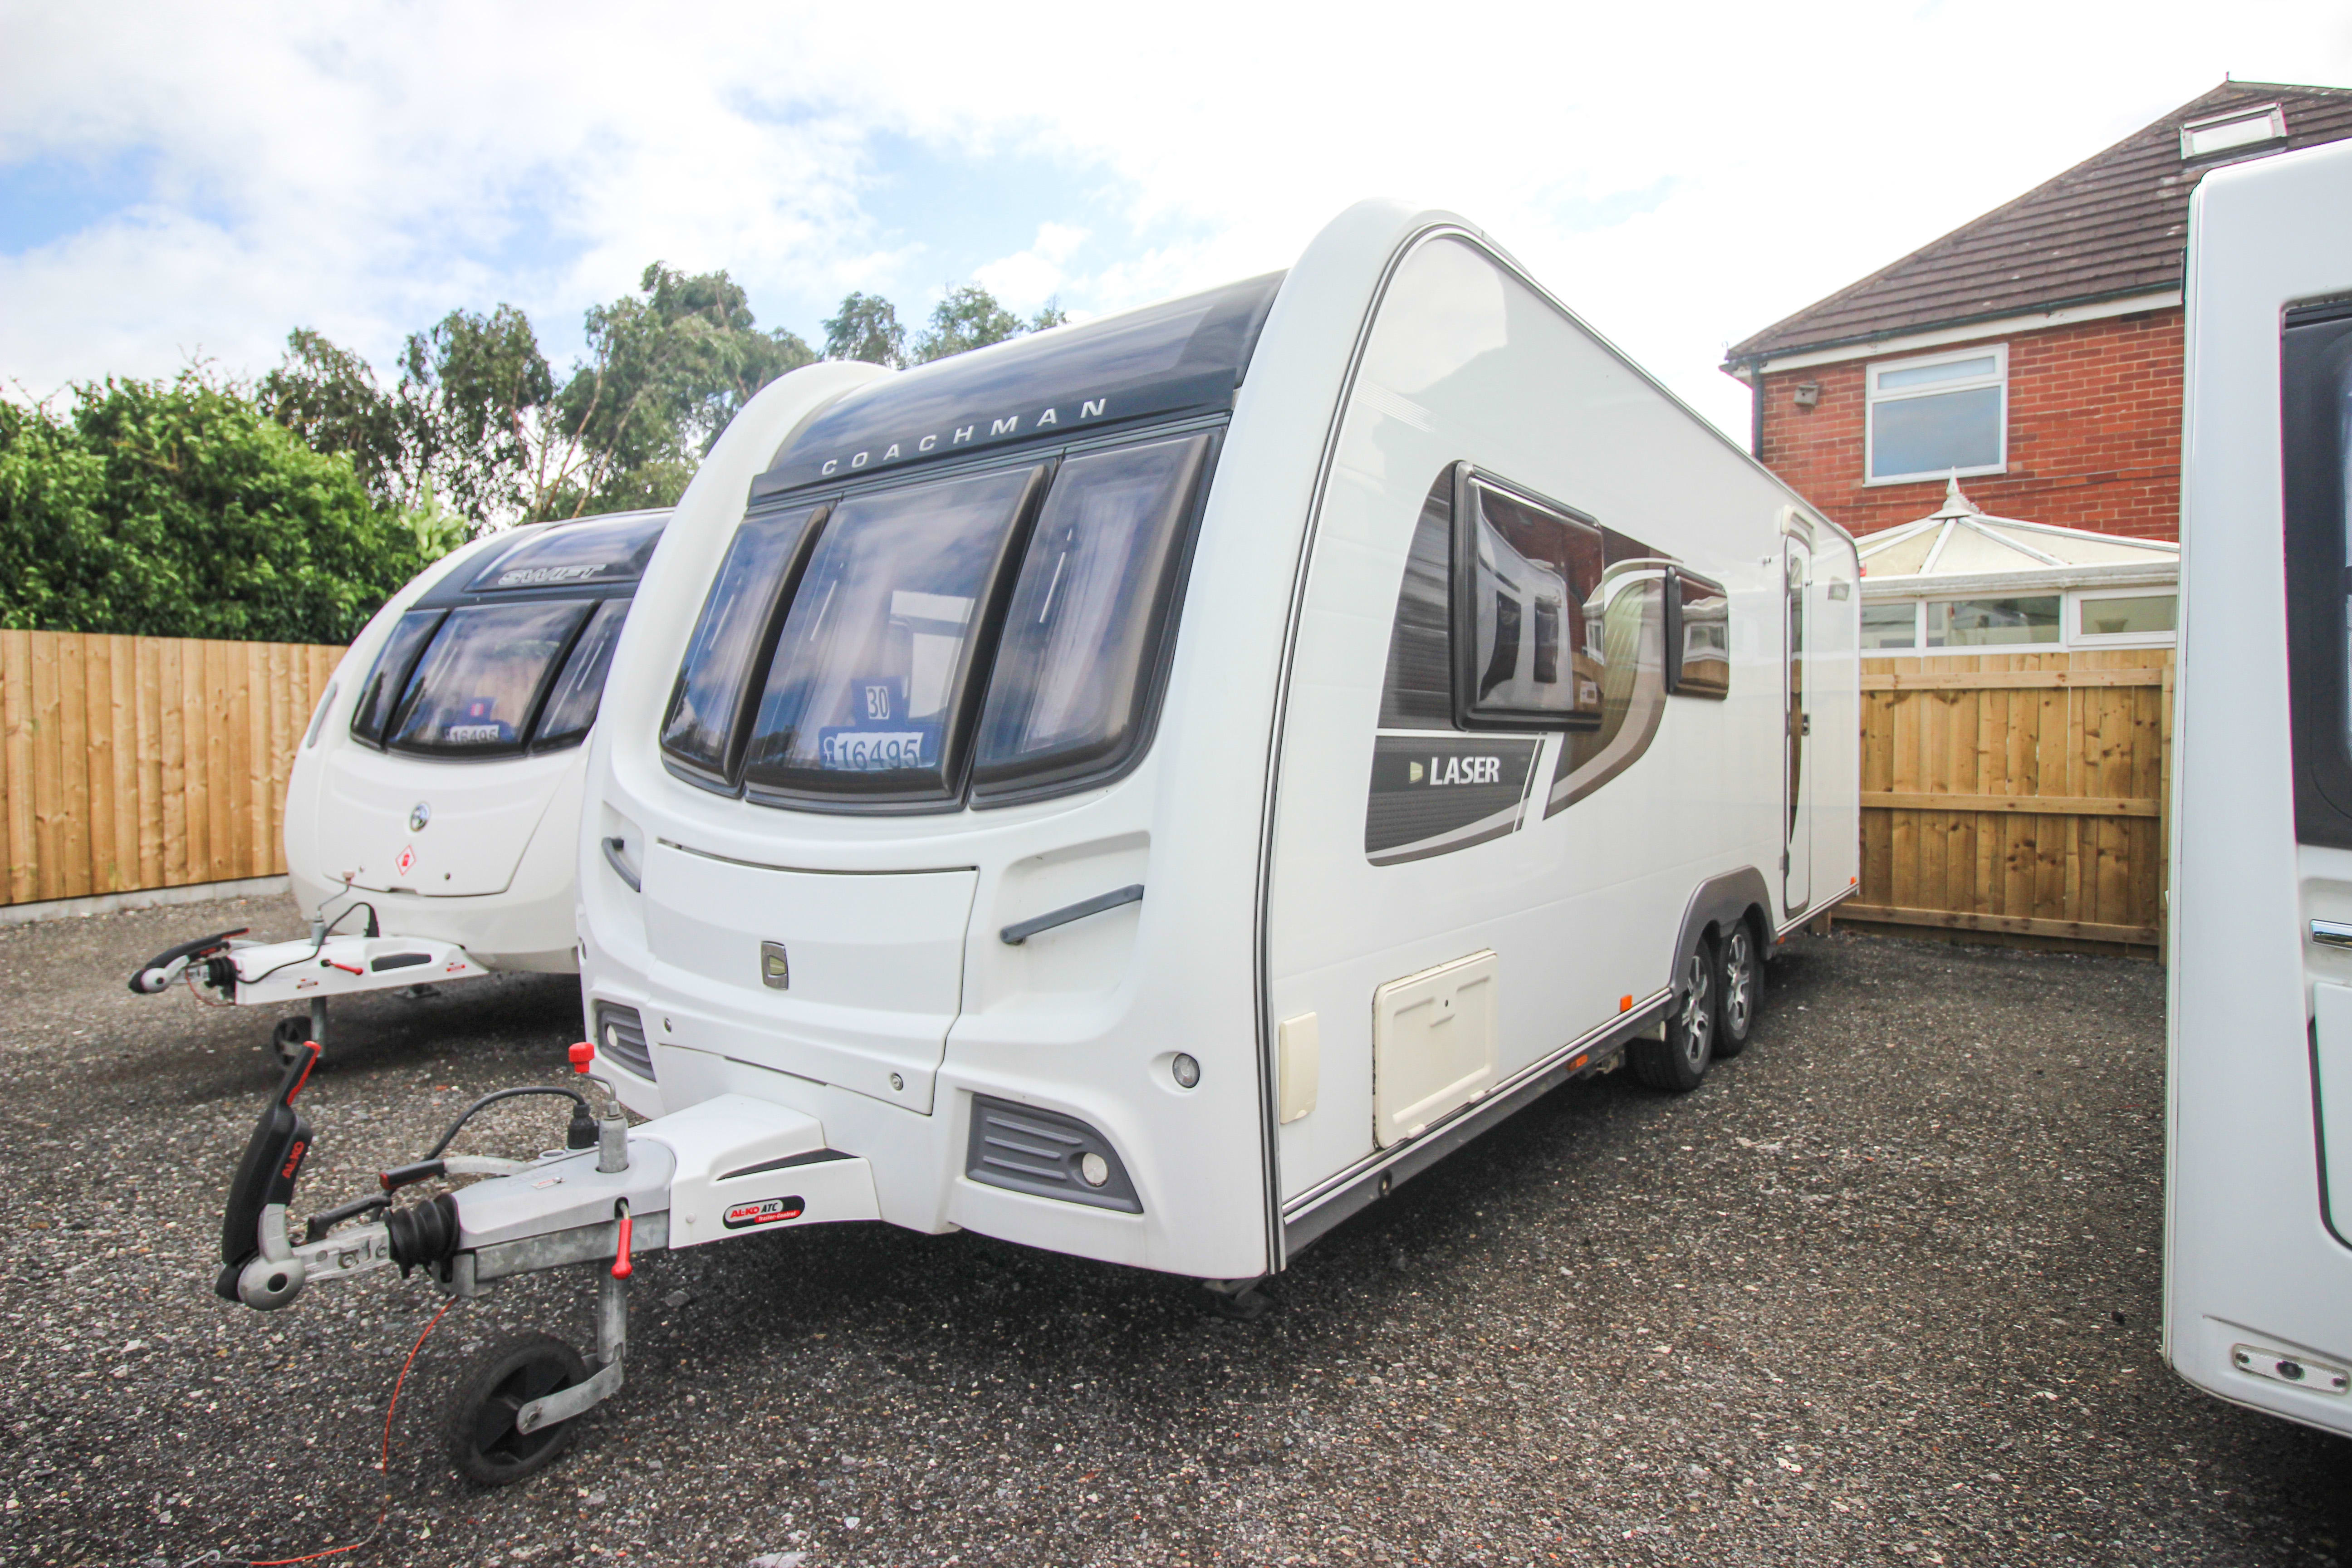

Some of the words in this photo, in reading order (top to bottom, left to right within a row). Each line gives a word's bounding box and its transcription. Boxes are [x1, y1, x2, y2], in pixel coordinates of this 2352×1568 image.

[822, 398, 1106, 475] COACHMAN
[498, 564, 607, 585] SWIFT
[867, 687, 888, 718] 30
[823, 736, 919, 770] £16495
[1430, 756, 1500, 785] LASER
[758, 1211, 796, 1221] Trailer-Control
[761, 1202, 778, 1213] ATC
